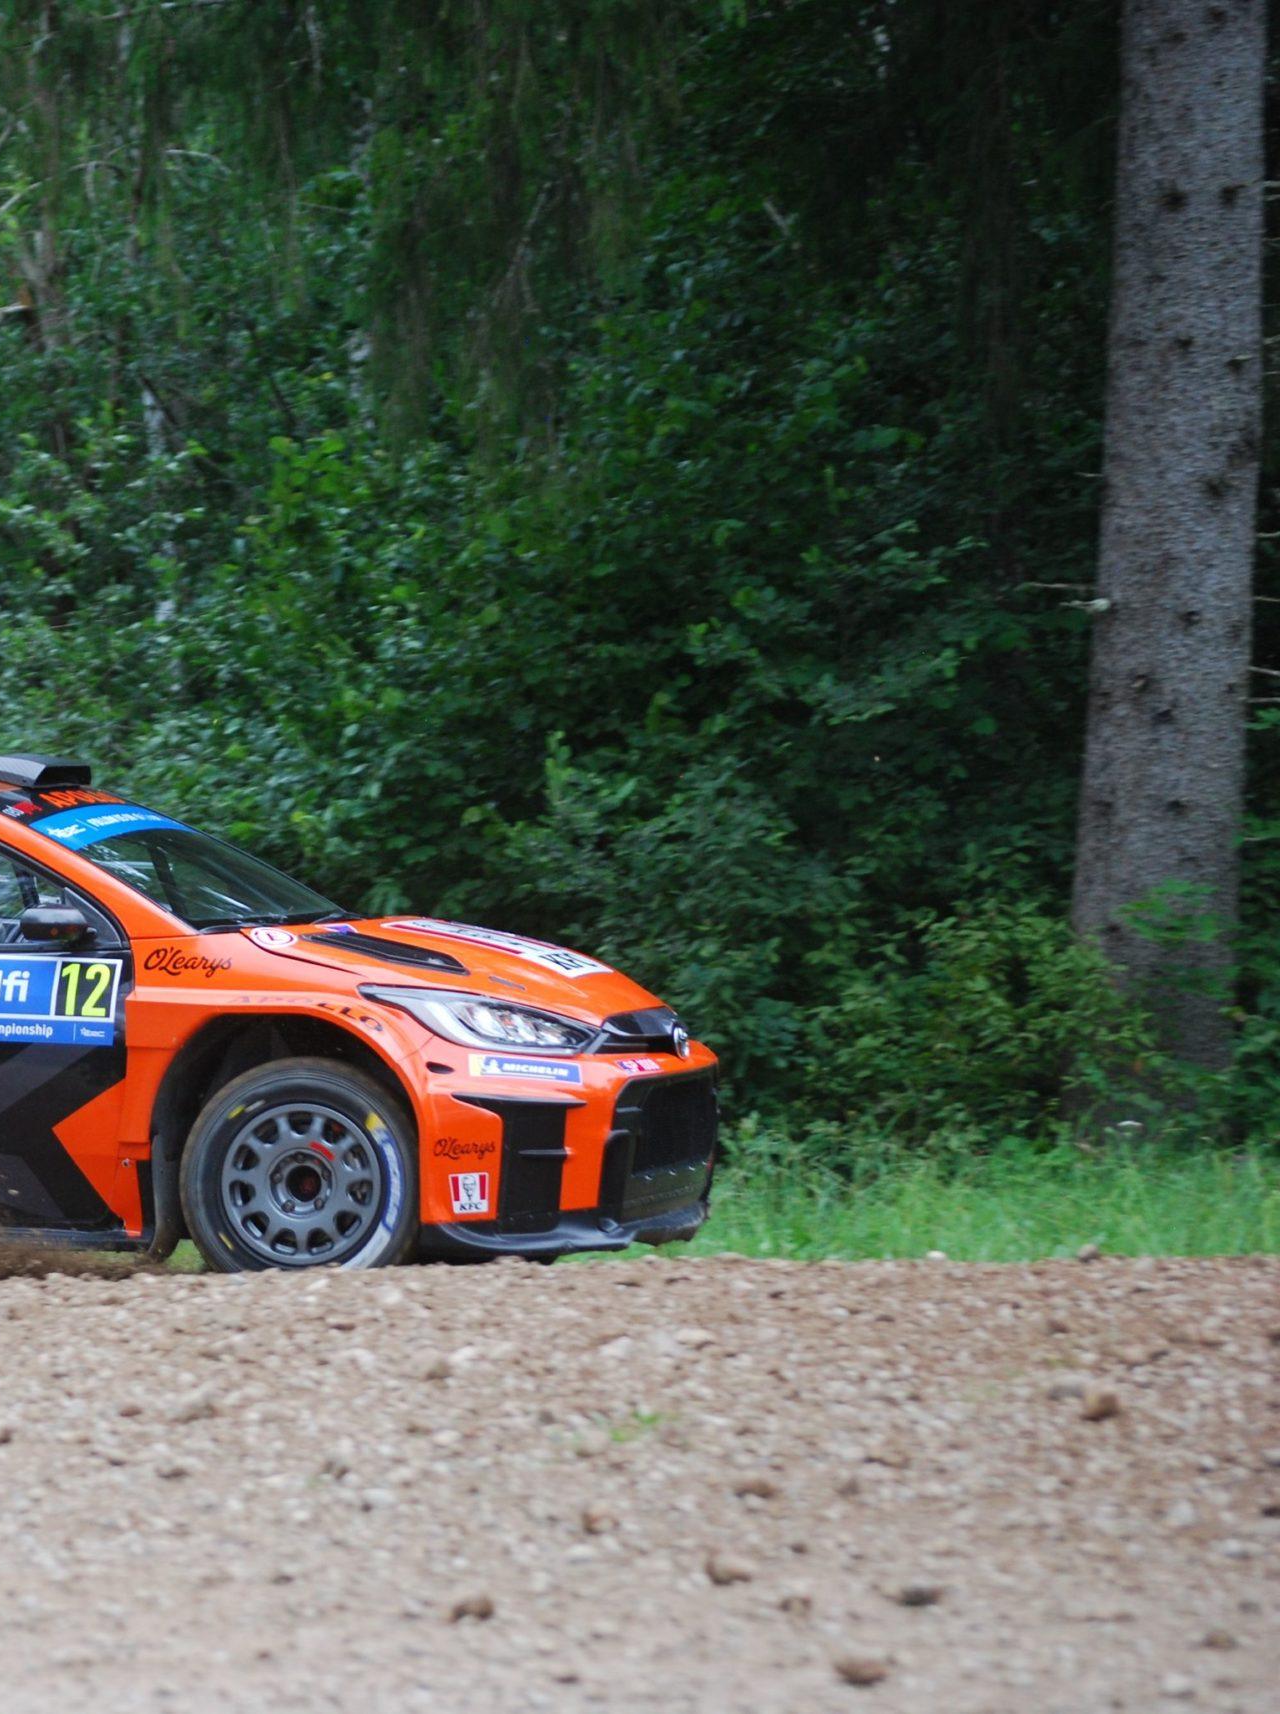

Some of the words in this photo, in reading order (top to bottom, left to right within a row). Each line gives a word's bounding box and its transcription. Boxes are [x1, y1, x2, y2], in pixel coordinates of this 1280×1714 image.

[144, 946, 233, 978] O'Learys
[61, 962, 112, 1017] 12
[502, 1063, 569, 1076] MICHELIN
[433, 1137, 496, 1160] O'Learys
[460, 1202, 482, 1212] KFC
